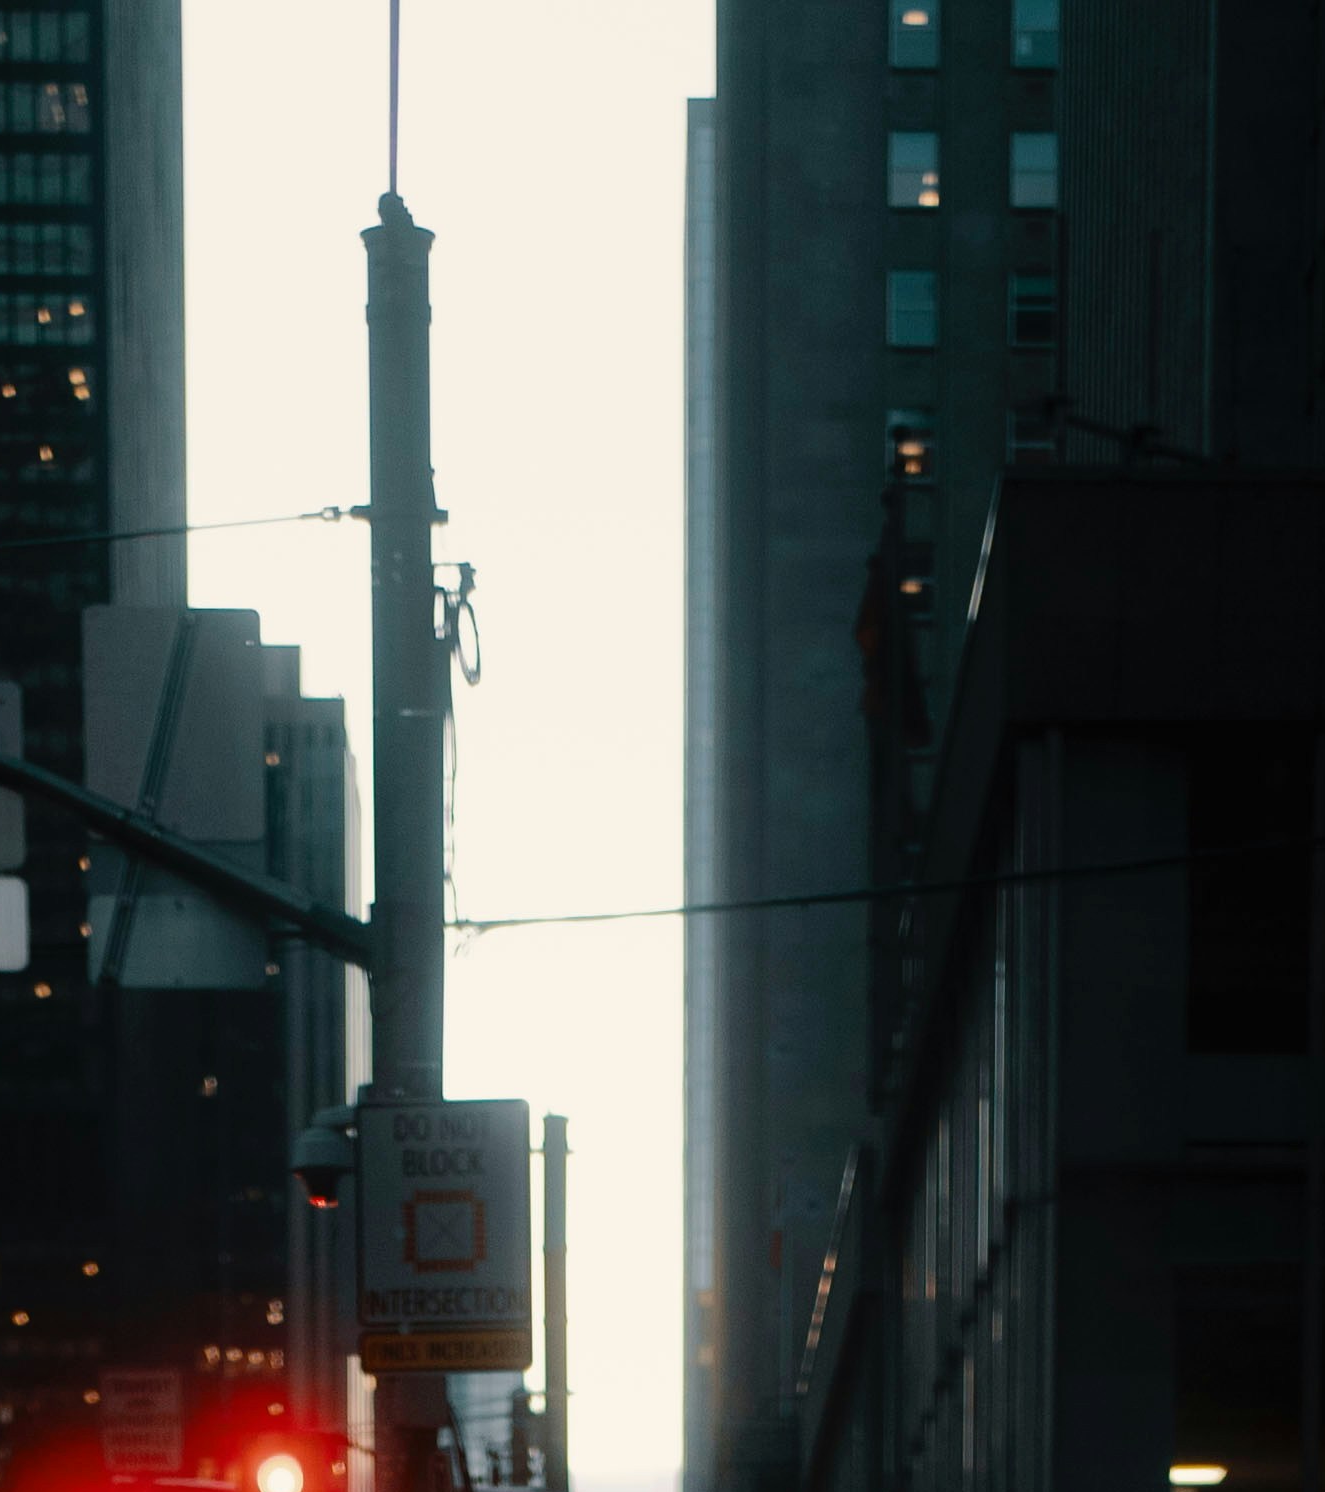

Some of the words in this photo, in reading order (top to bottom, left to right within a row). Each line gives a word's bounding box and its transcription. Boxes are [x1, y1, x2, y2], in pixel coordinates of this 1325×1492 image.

[393, 1113, 431, 1141] DO
[402, 1148, 485, 1177] BLOCK
[365, 1287, 519, 1316] INTERSECTION
